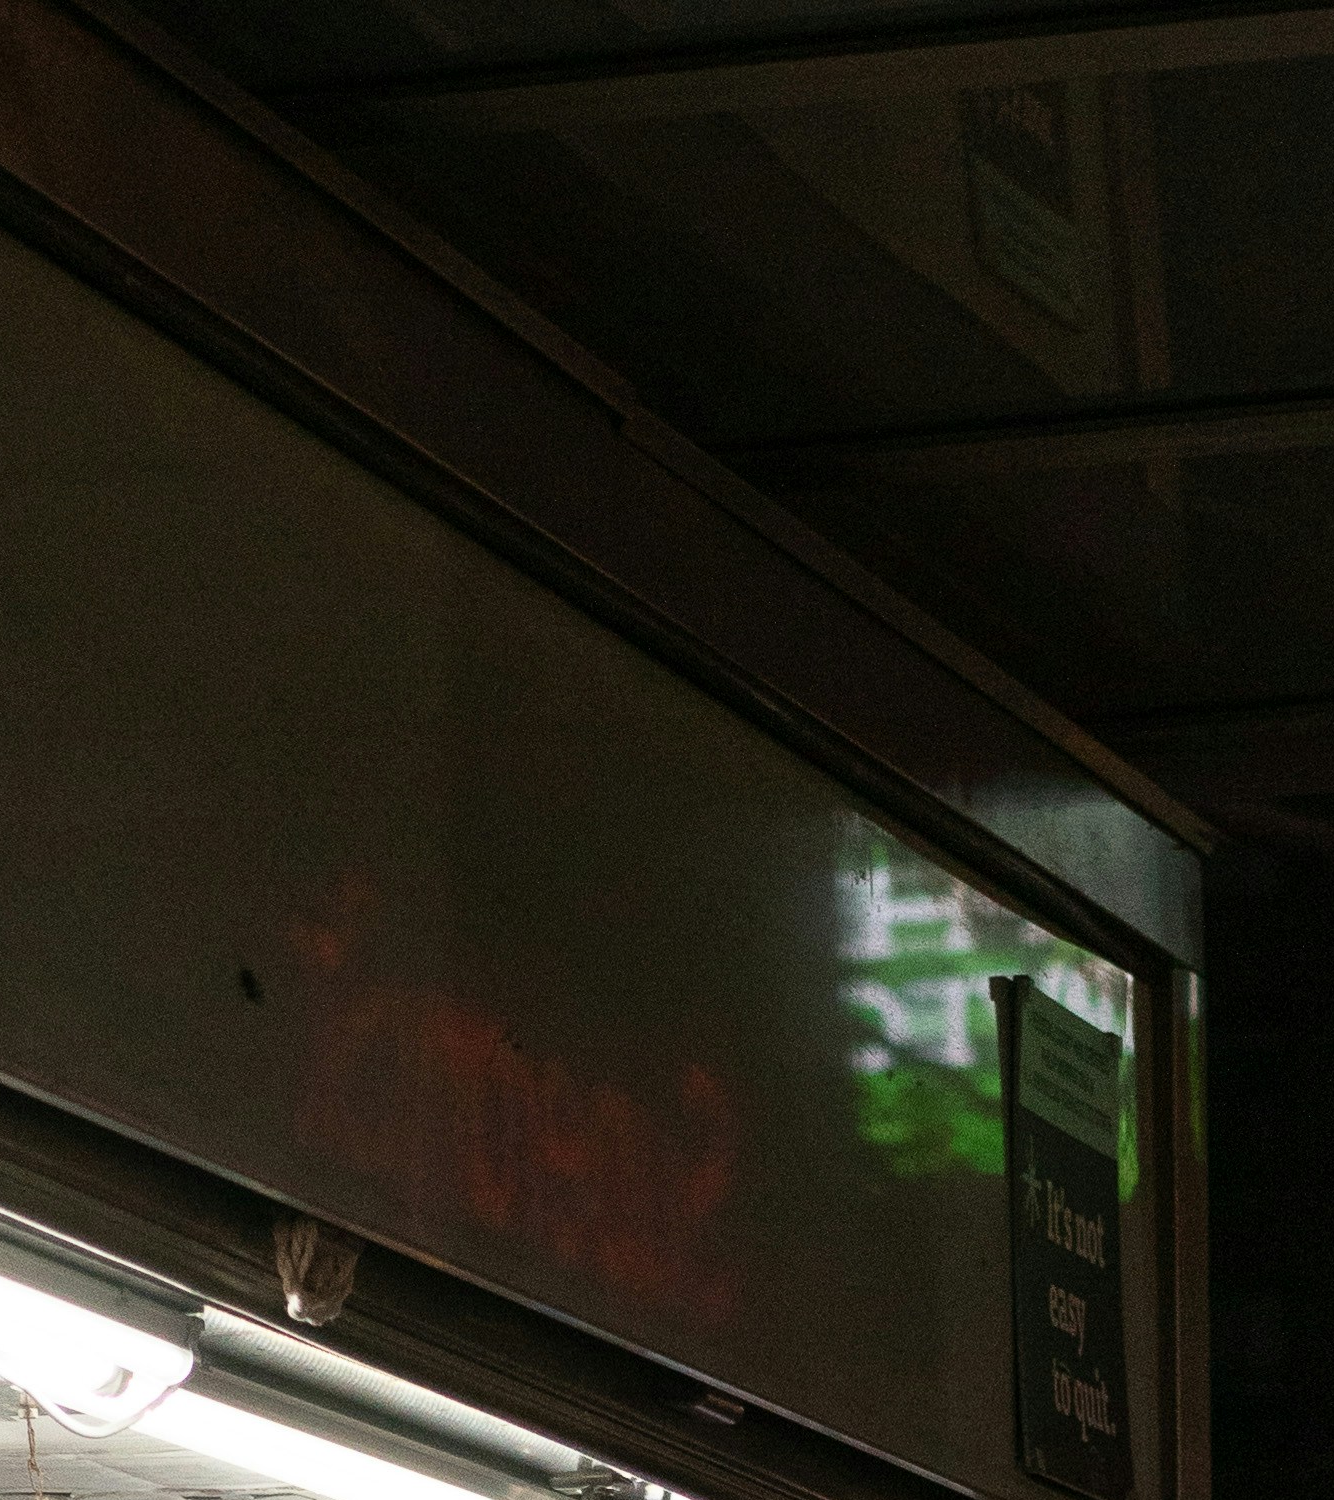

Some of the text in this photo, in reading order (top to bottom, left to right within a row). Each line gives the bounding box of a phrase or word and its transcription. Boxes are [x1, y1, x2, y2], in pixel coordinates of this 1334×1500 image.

[1046, 1179, 1106, 1268] It's not
[1049, 1284, 1086, 1357] easy
[1052, 1357, 1072, 1416] to
